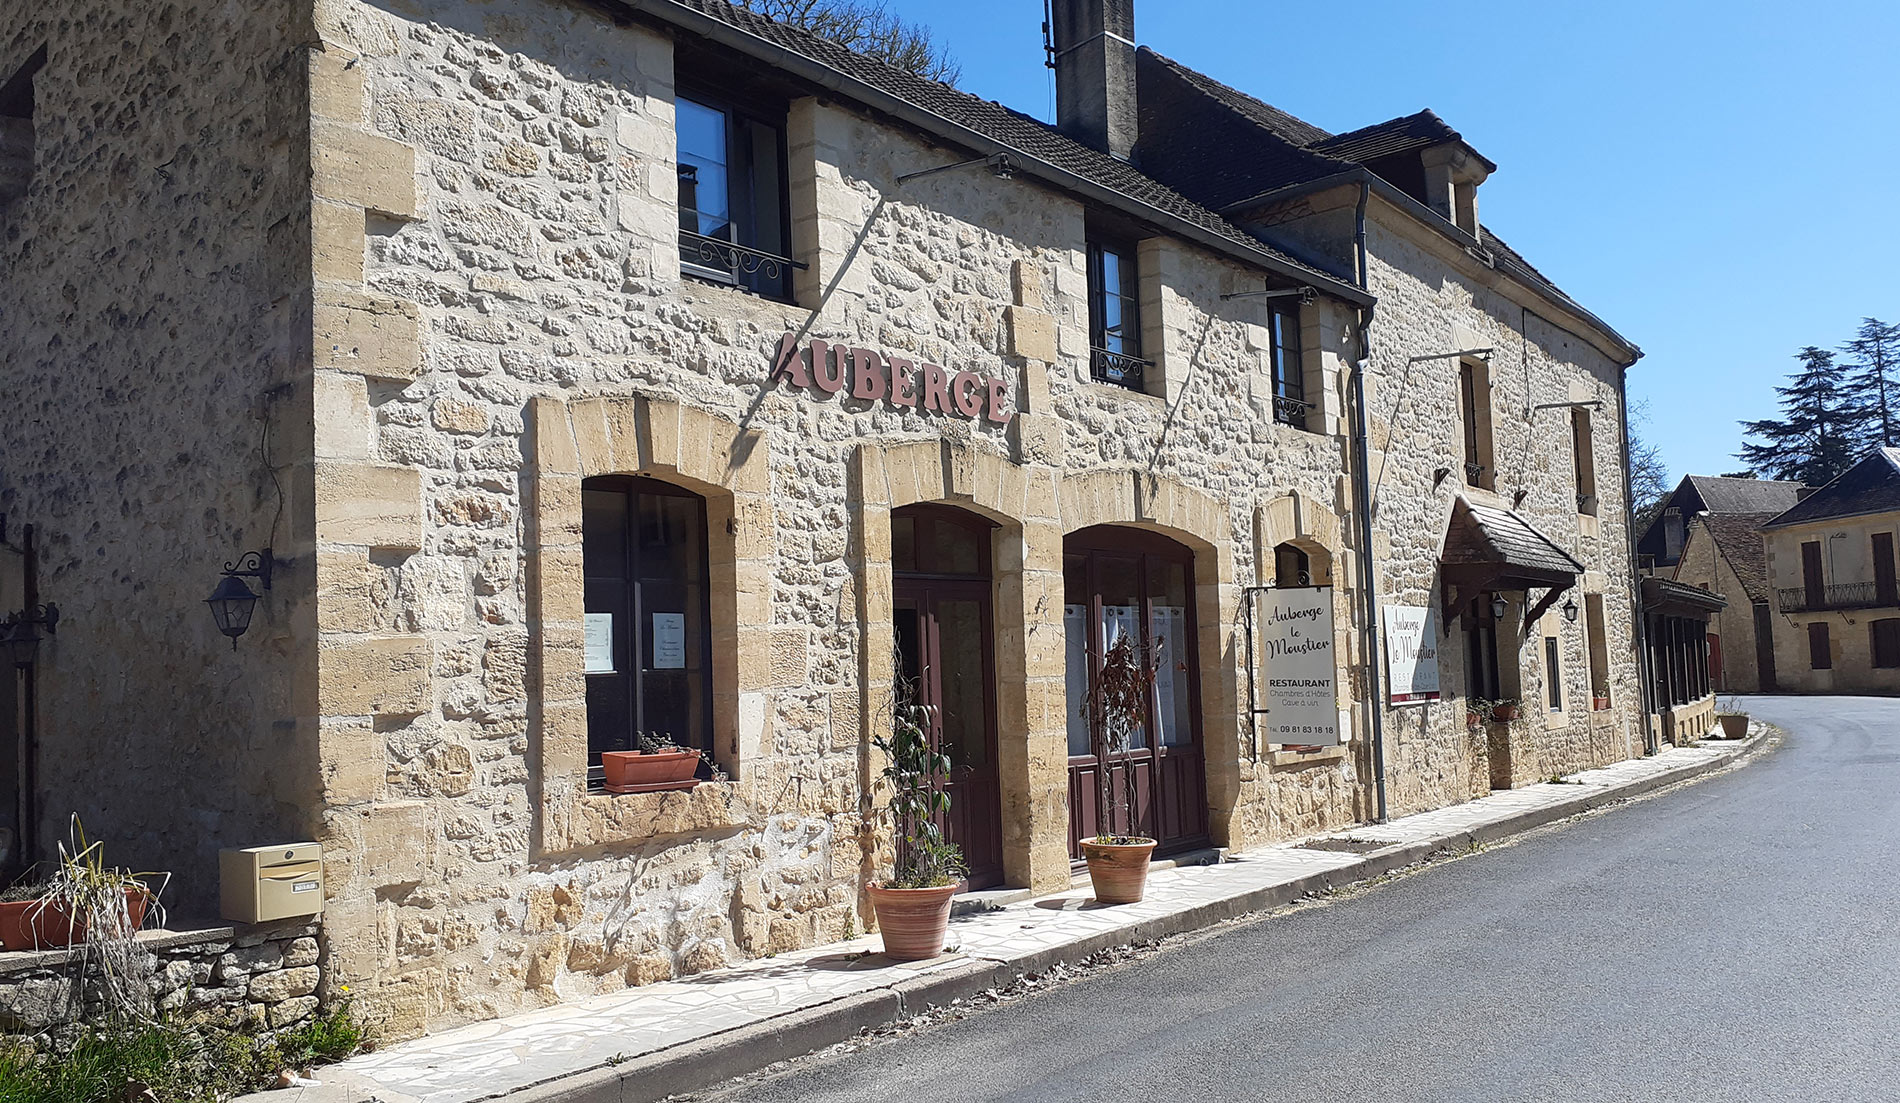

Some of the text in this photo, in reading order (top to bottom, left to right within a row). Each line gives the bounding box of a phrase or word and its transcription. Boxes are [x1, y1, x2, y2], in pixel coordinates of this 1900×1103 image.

[771, 332, 1012, 424] AUBERGE
[1268, 605, 1325, 626] Auberge
[1392, 608, 1420, 637] Auberge
[1265, 637, 1330, 660] Moustier
[1269, 679, 1331, 688] RESTAURANT
[1270, 689, 1304, 698] Chambres
[1281, 698, 1300, 707] Cave
[1280, 725, 1291, 733] 09
[1291, 725, 1301, 734] 81
[1302, 725, 1313, 734] 83
[1314, 726, 1323, 734] 18
[1325, 726, 1334, 735] 18
